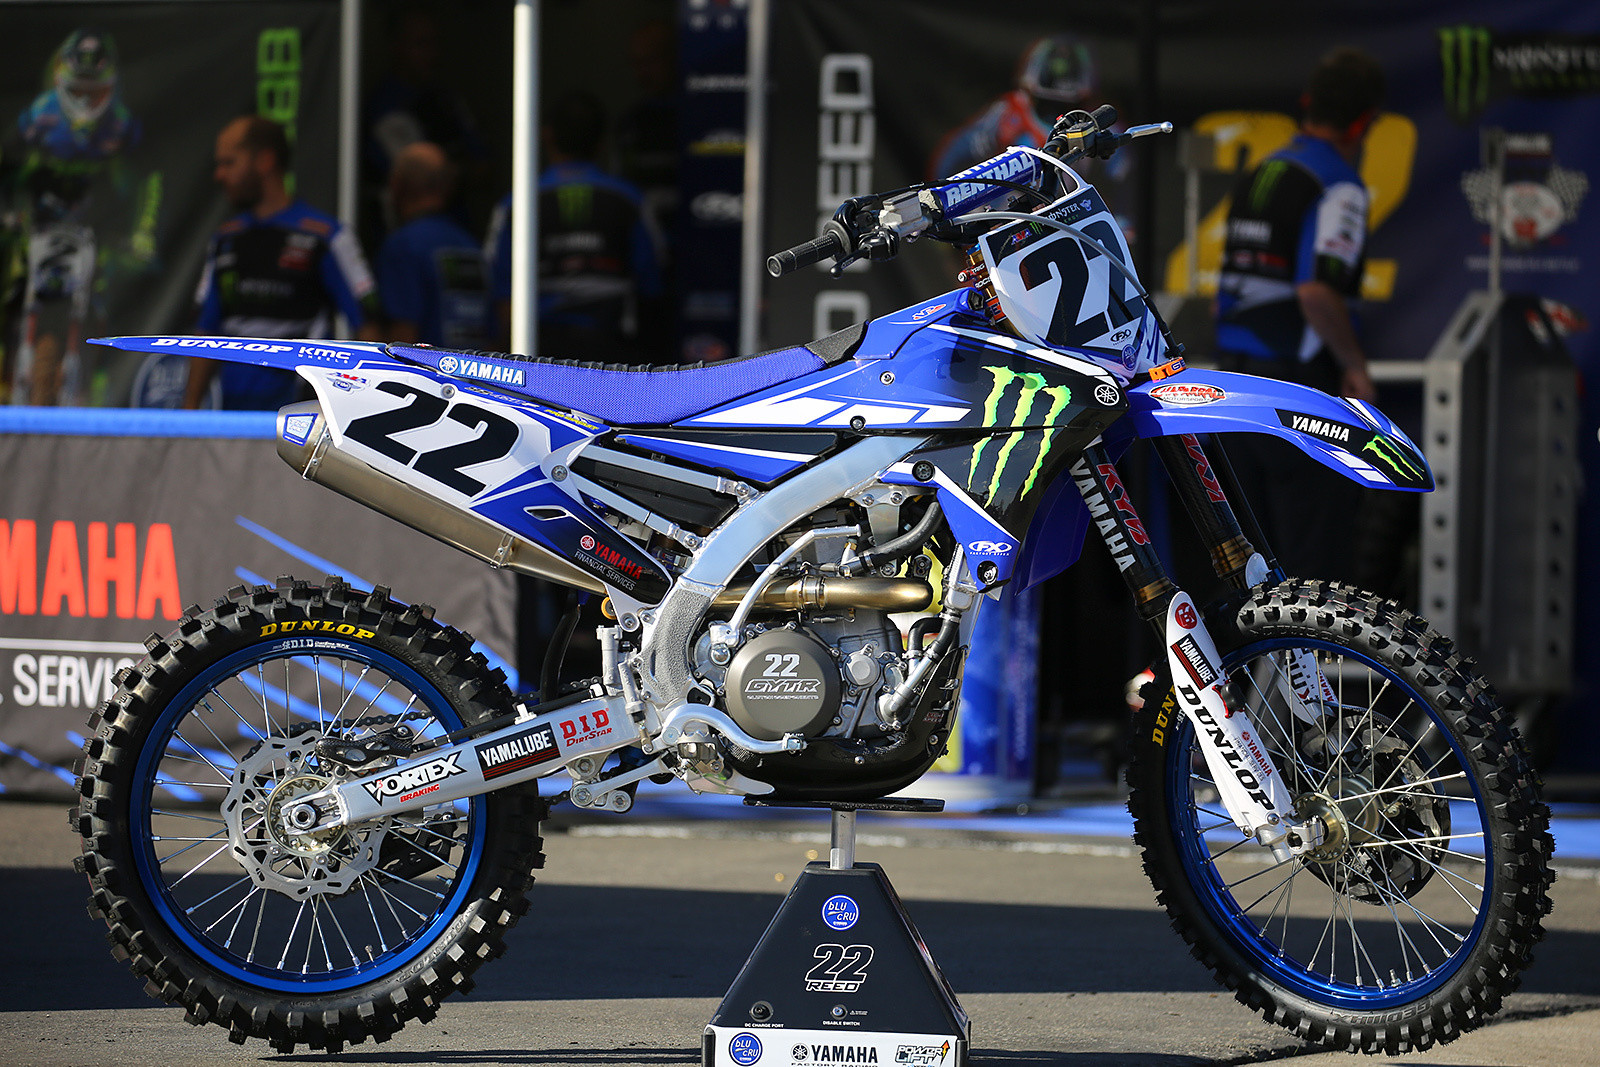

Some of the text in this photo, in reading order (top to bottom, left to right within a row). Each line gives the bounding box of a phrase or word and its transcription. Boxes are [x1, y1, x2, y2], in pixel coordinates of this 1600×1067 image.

[945, 153, 1034, 207] RENTHAL
[1047, 203, 1081, 221] ONSTER
[150, 338, 294, 354] DUNLOP
[459, 359, 524, 385] YAMAHA
[344, 381, 519, 497] 22
[1291, 415, 1350, 442] YAMAHA
[1069, 456, 1136, 573] YAMAHA
[1096, 463, 1152, 546] KYB
[574, 550, 636, 591] FINANCIAL SERVICES
[594, 541, 643, 580] YAMAHA
[259, 620, 376, 639] DUNLOP
[762, 653, 800, 677] 22
[1178, 637, 1216, 685] YAMALUBE
[744, 678, 821, 693] GYTR
[480, 730, 553, 768] YAMALUBE
[1177, 684, 1276, 812] DUNLOP
[1247, 739, 1273, 777] YAMAHA
[362, 752, 467, 805] VORTEX
[400, 784, 441, 803] BRAKING
[804, 943, 875, 984] 22
[805, 980, 861, 993] REED
[811, 1044, 879, 1063] YAMAHA
[895, 1051, 936, 1064] LIFT
[897, 1045, 943, 1056] POWER
